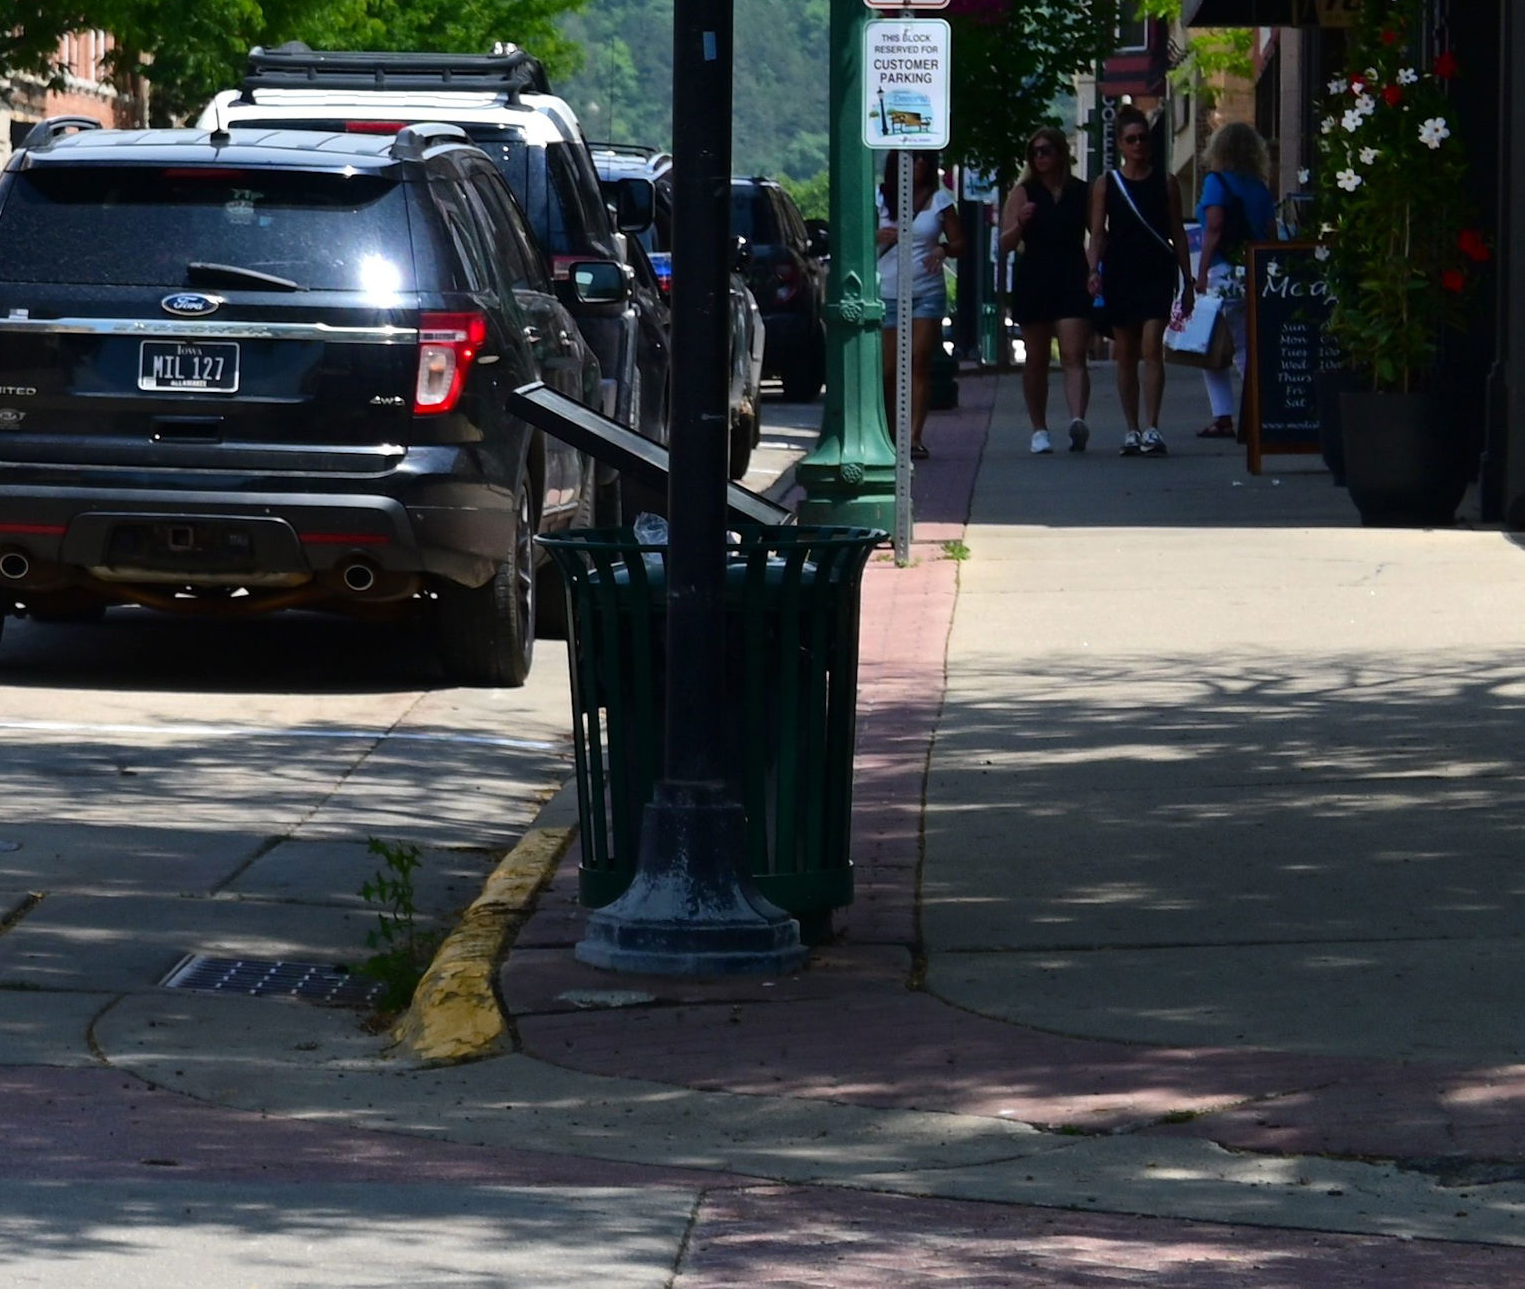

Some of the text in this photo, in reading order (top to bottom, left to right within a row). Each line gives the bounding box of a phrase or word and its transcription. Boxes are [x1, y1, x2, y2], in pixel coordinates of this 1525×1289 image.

[882, 33, 931, 42] THIS BLOCK
[875, 46, 938, 54] RESERVED FOR
[874, 59, 939, 70] CUSTOMER
[880, 73, 932, 84] PARKING
[172, 295, 204, 311] Ford
[154, 356, 224, 381] MIL 127
